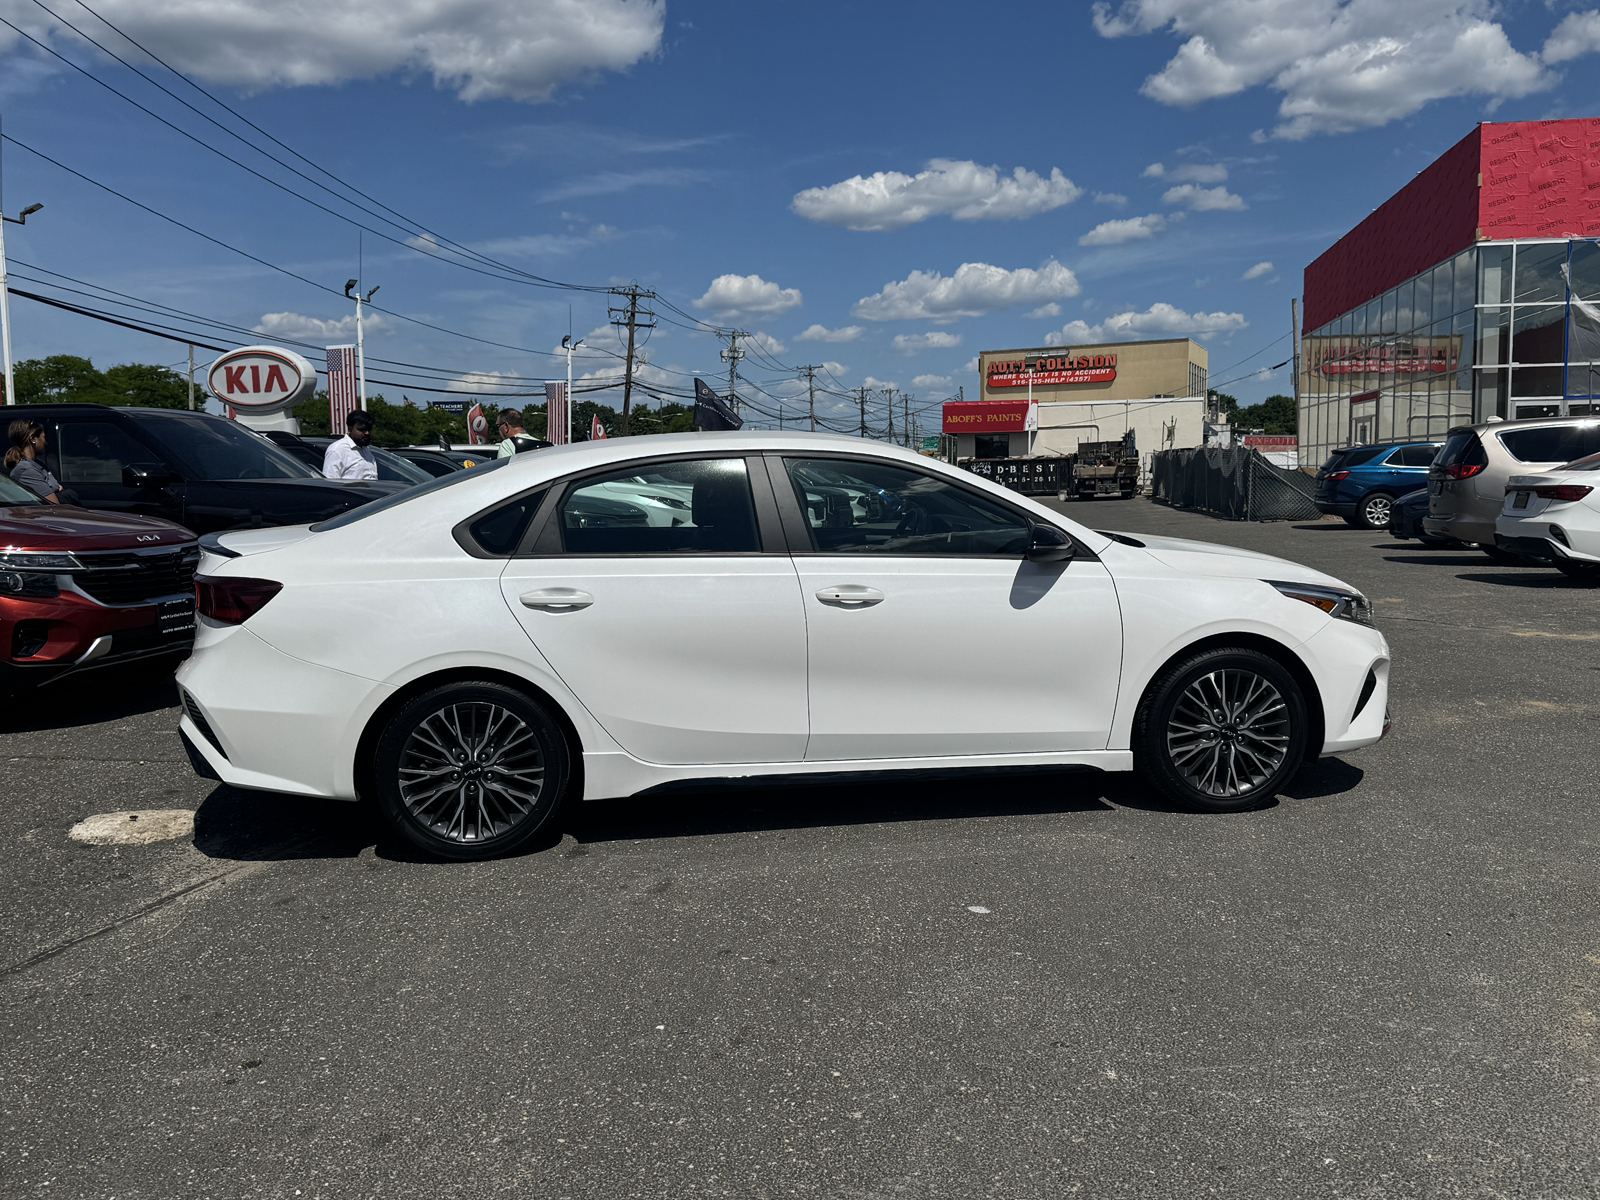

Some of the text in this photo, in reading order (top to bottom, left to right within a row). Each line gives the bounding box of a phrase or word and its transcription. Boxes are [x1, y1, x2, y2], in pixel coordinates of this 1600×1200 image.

[1489, 153, 1517, 167] RESISTO
[1538, 177, 1566, 191] RESISTO
[1488, 195, 1516, 208] RESISTO
[1536, 219, 1565, 232] RESISTO
[988, 354, 1117, 373] AUTO COLLISION
[224, 364, 289, 394] KIA
[1011, 375, 1091, 386] 516-35-HELP (4357)
[946, 414, 982, 423] ABOFF'S
[987, 413, 1022, 422] PAINTS
